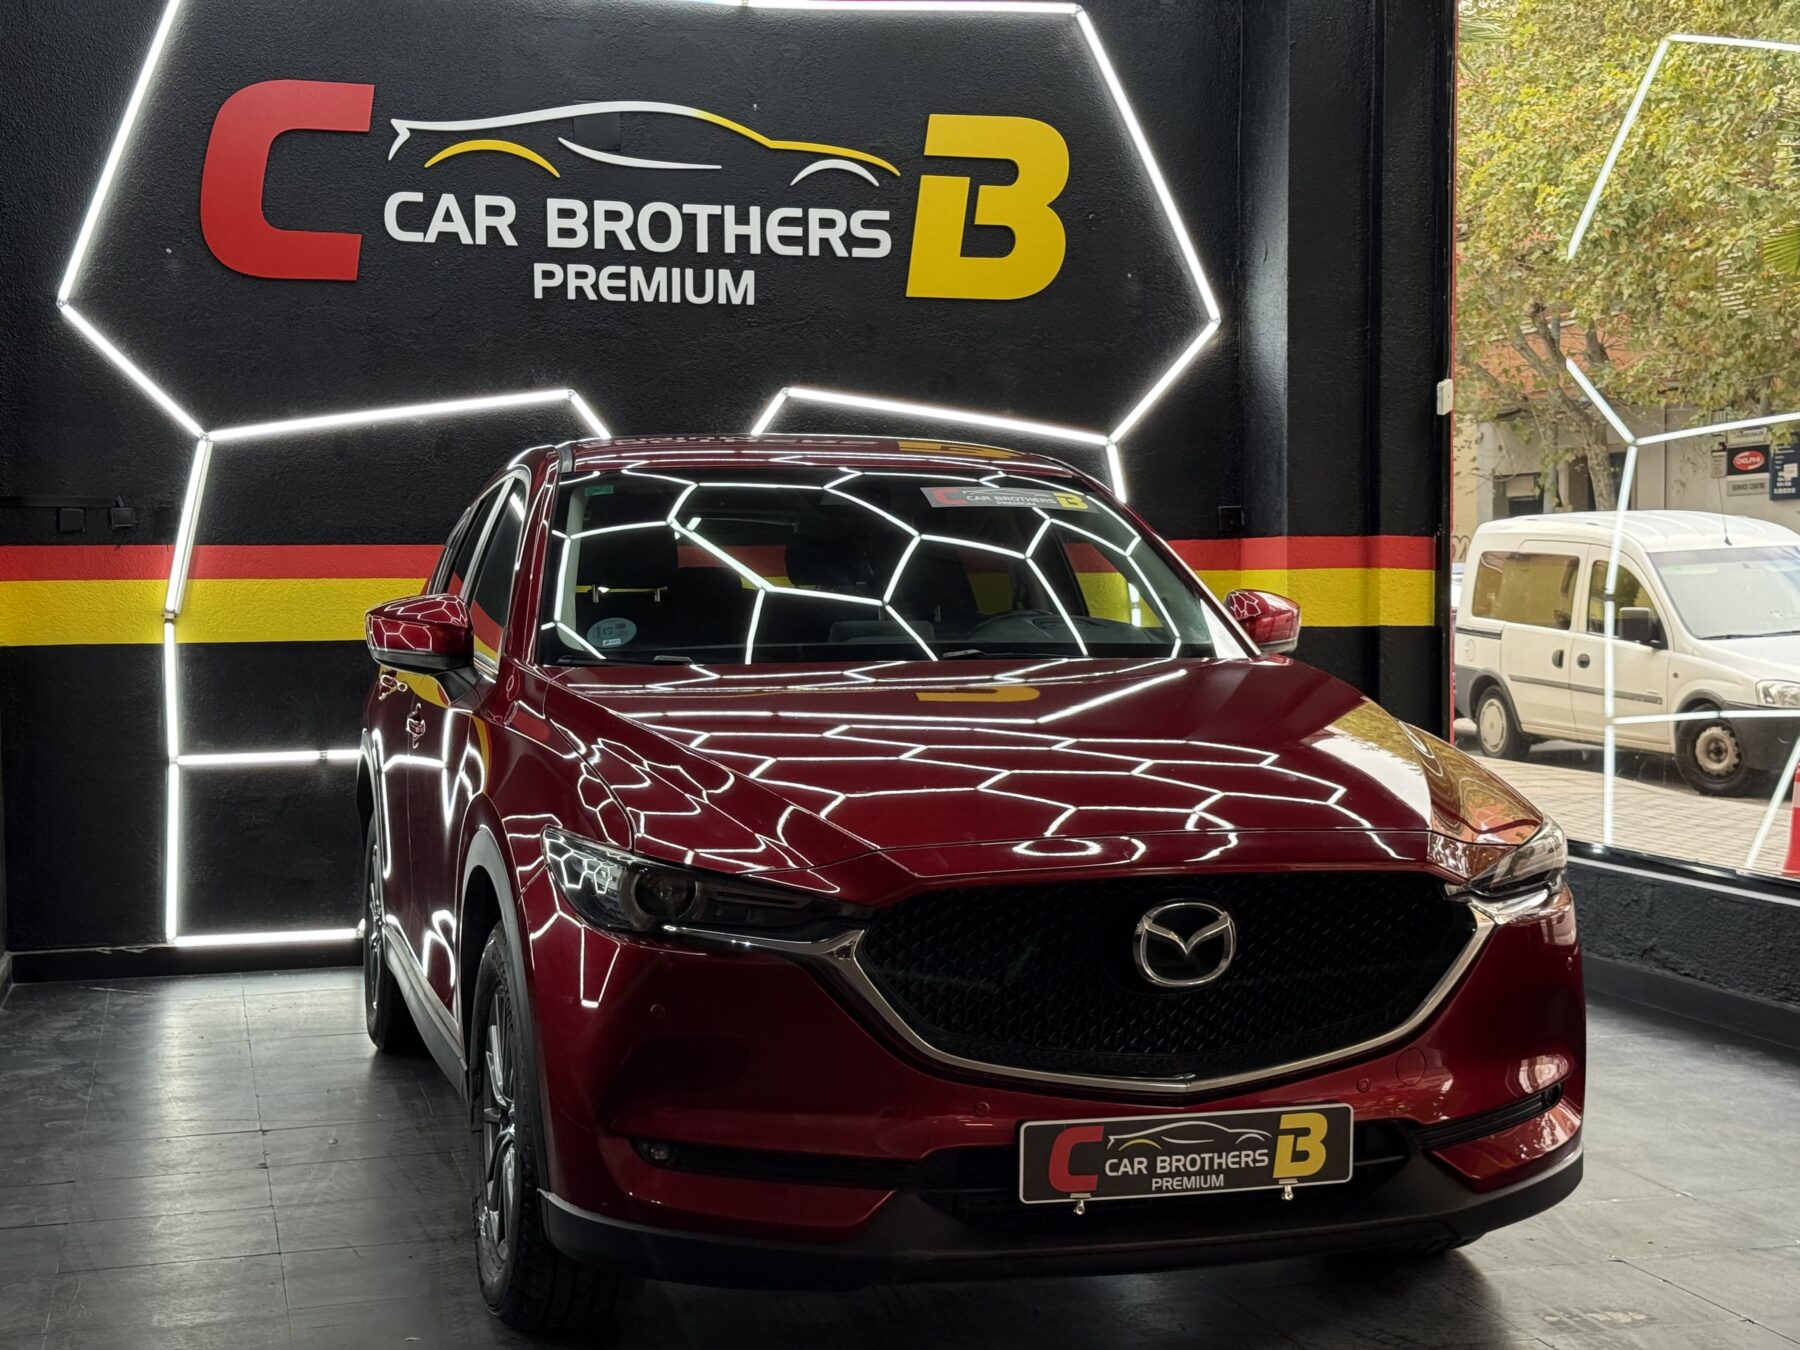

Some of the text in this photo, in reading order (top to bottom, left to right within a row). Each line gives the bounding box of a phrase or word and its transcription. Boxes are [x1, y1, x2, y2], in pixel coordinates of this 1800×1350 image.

[201, 80, 374, 281] C
[384, 191, 892, 258] CAR BROTHERS
[906, 113, 1070, 301] B
[533, 262, 756, 306] PREMIUM
[932, 487, 967, 505] C
[993, 495, 1057, 504] BROTHERS
[1053, 492, 1089, 510] B
[1048, 1125, 1105, 1193] C
[1104, 1149, 1269, 1177] CAR BROTHERS
[1272, 1112, 1328, 1179] B
[1151, 1173, 1225, 1192] PREMIUM
